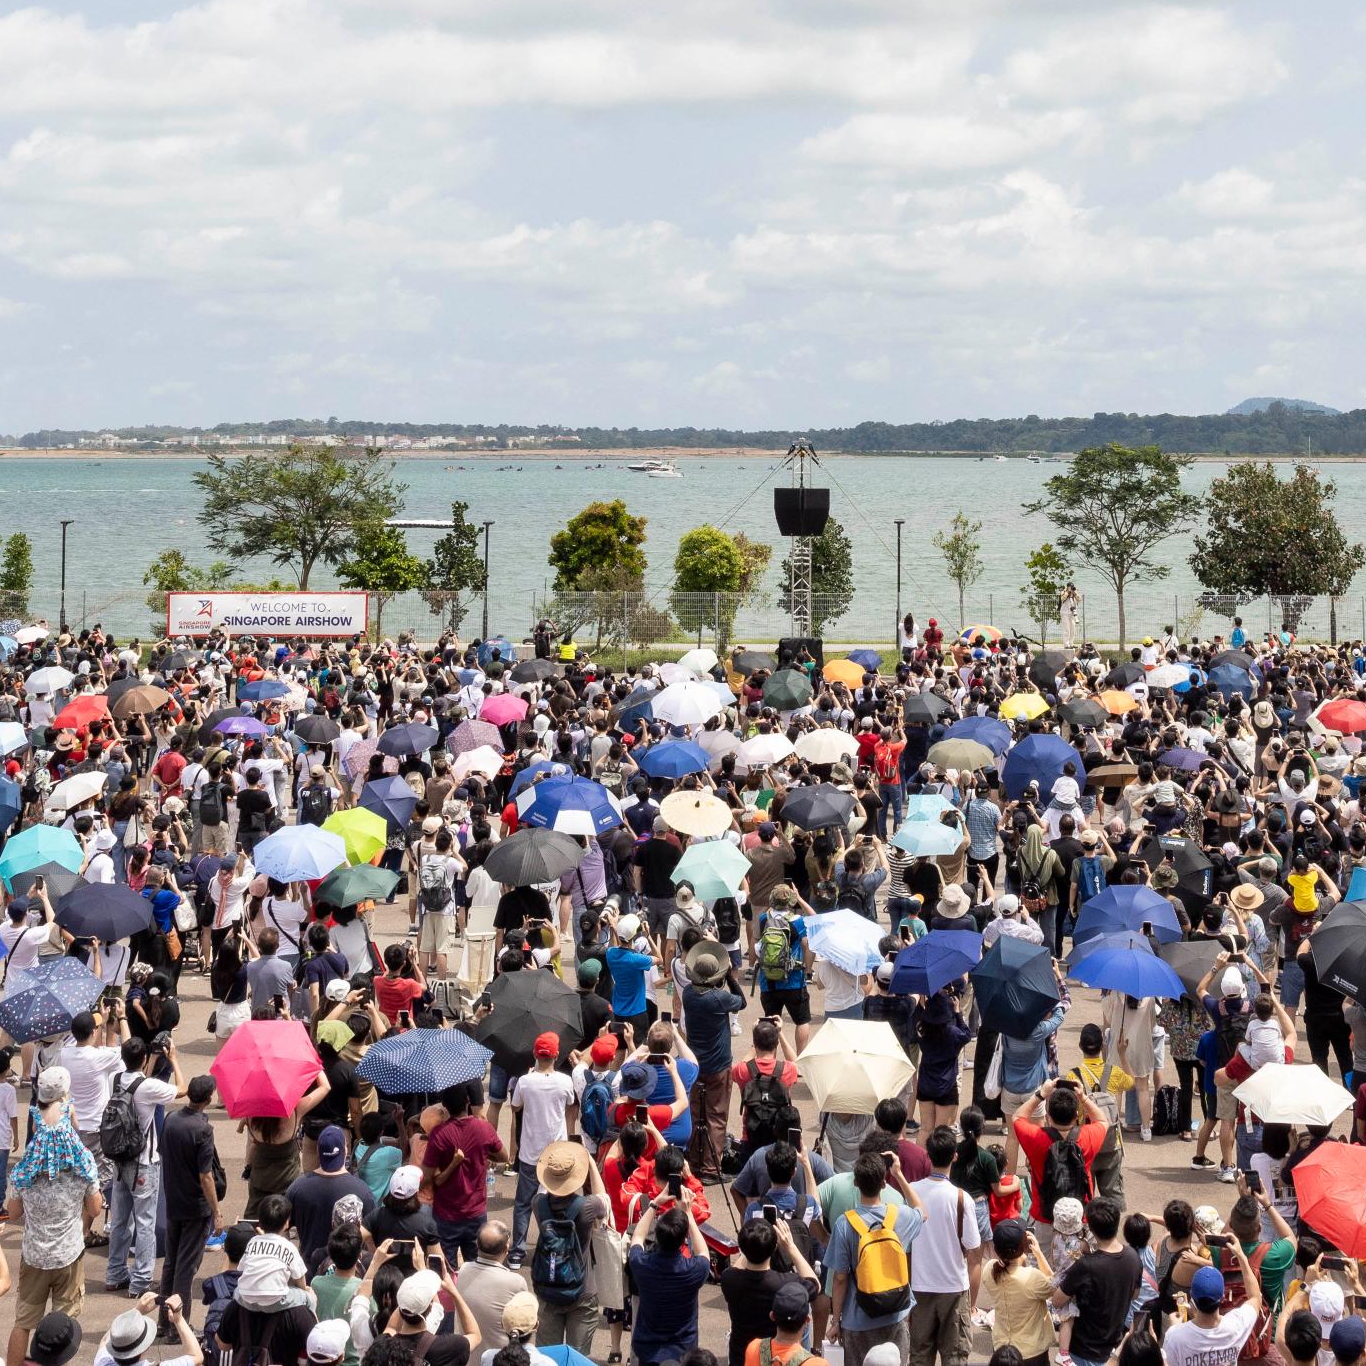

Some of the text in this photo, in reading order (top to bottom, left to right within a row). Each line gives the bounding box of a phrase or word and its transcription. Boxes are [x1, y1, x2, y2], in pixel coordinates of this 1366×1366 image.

[250, 602, 327, 613] WELCOME TO
[224, 616, 353, 626] SINGAPORE AIRSHOW
